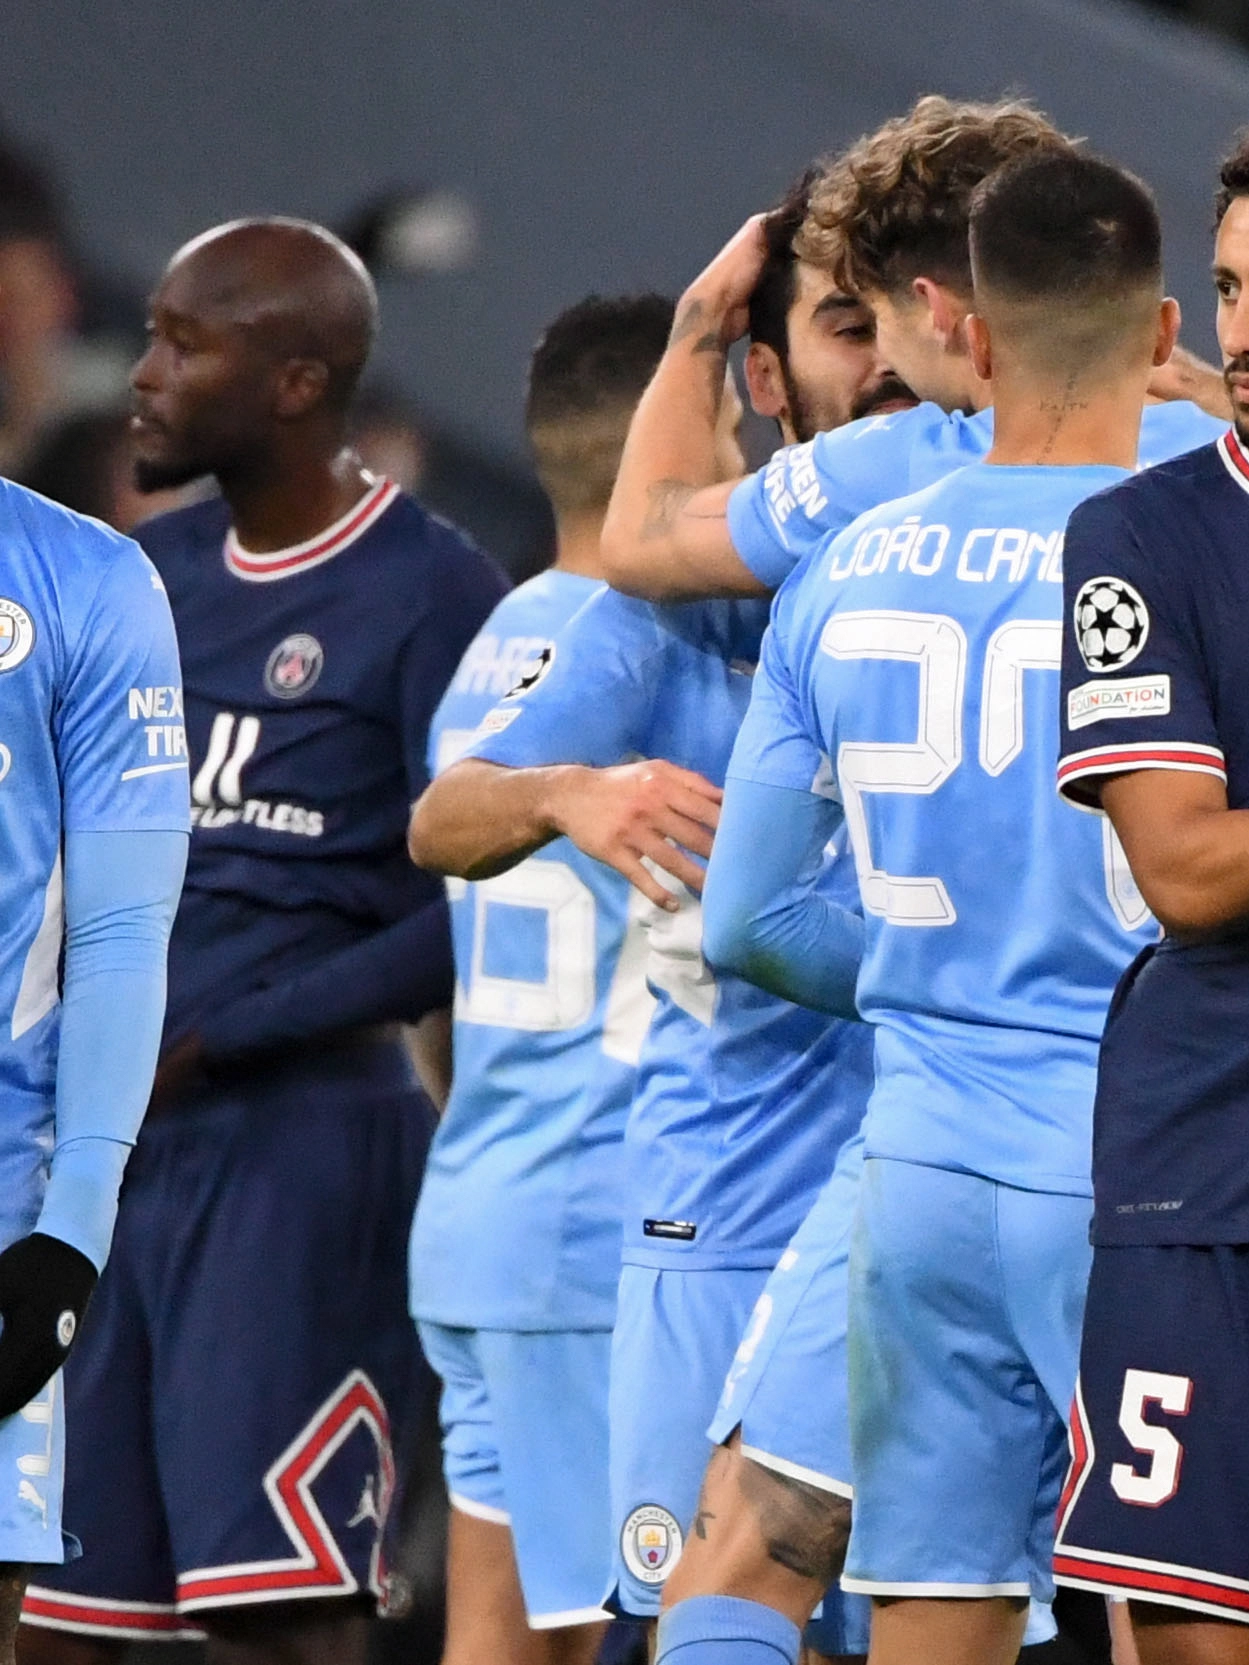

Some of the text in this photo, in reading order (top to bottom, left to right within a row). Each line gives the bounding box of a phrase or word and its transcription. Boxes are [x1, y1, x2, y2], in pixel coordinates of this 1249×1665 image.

[828, 515, 951, 581] JOÃO
[1069, 688, 1165, 713] FOUNDATION
[1110, 1368, 1194, 1509] 5
